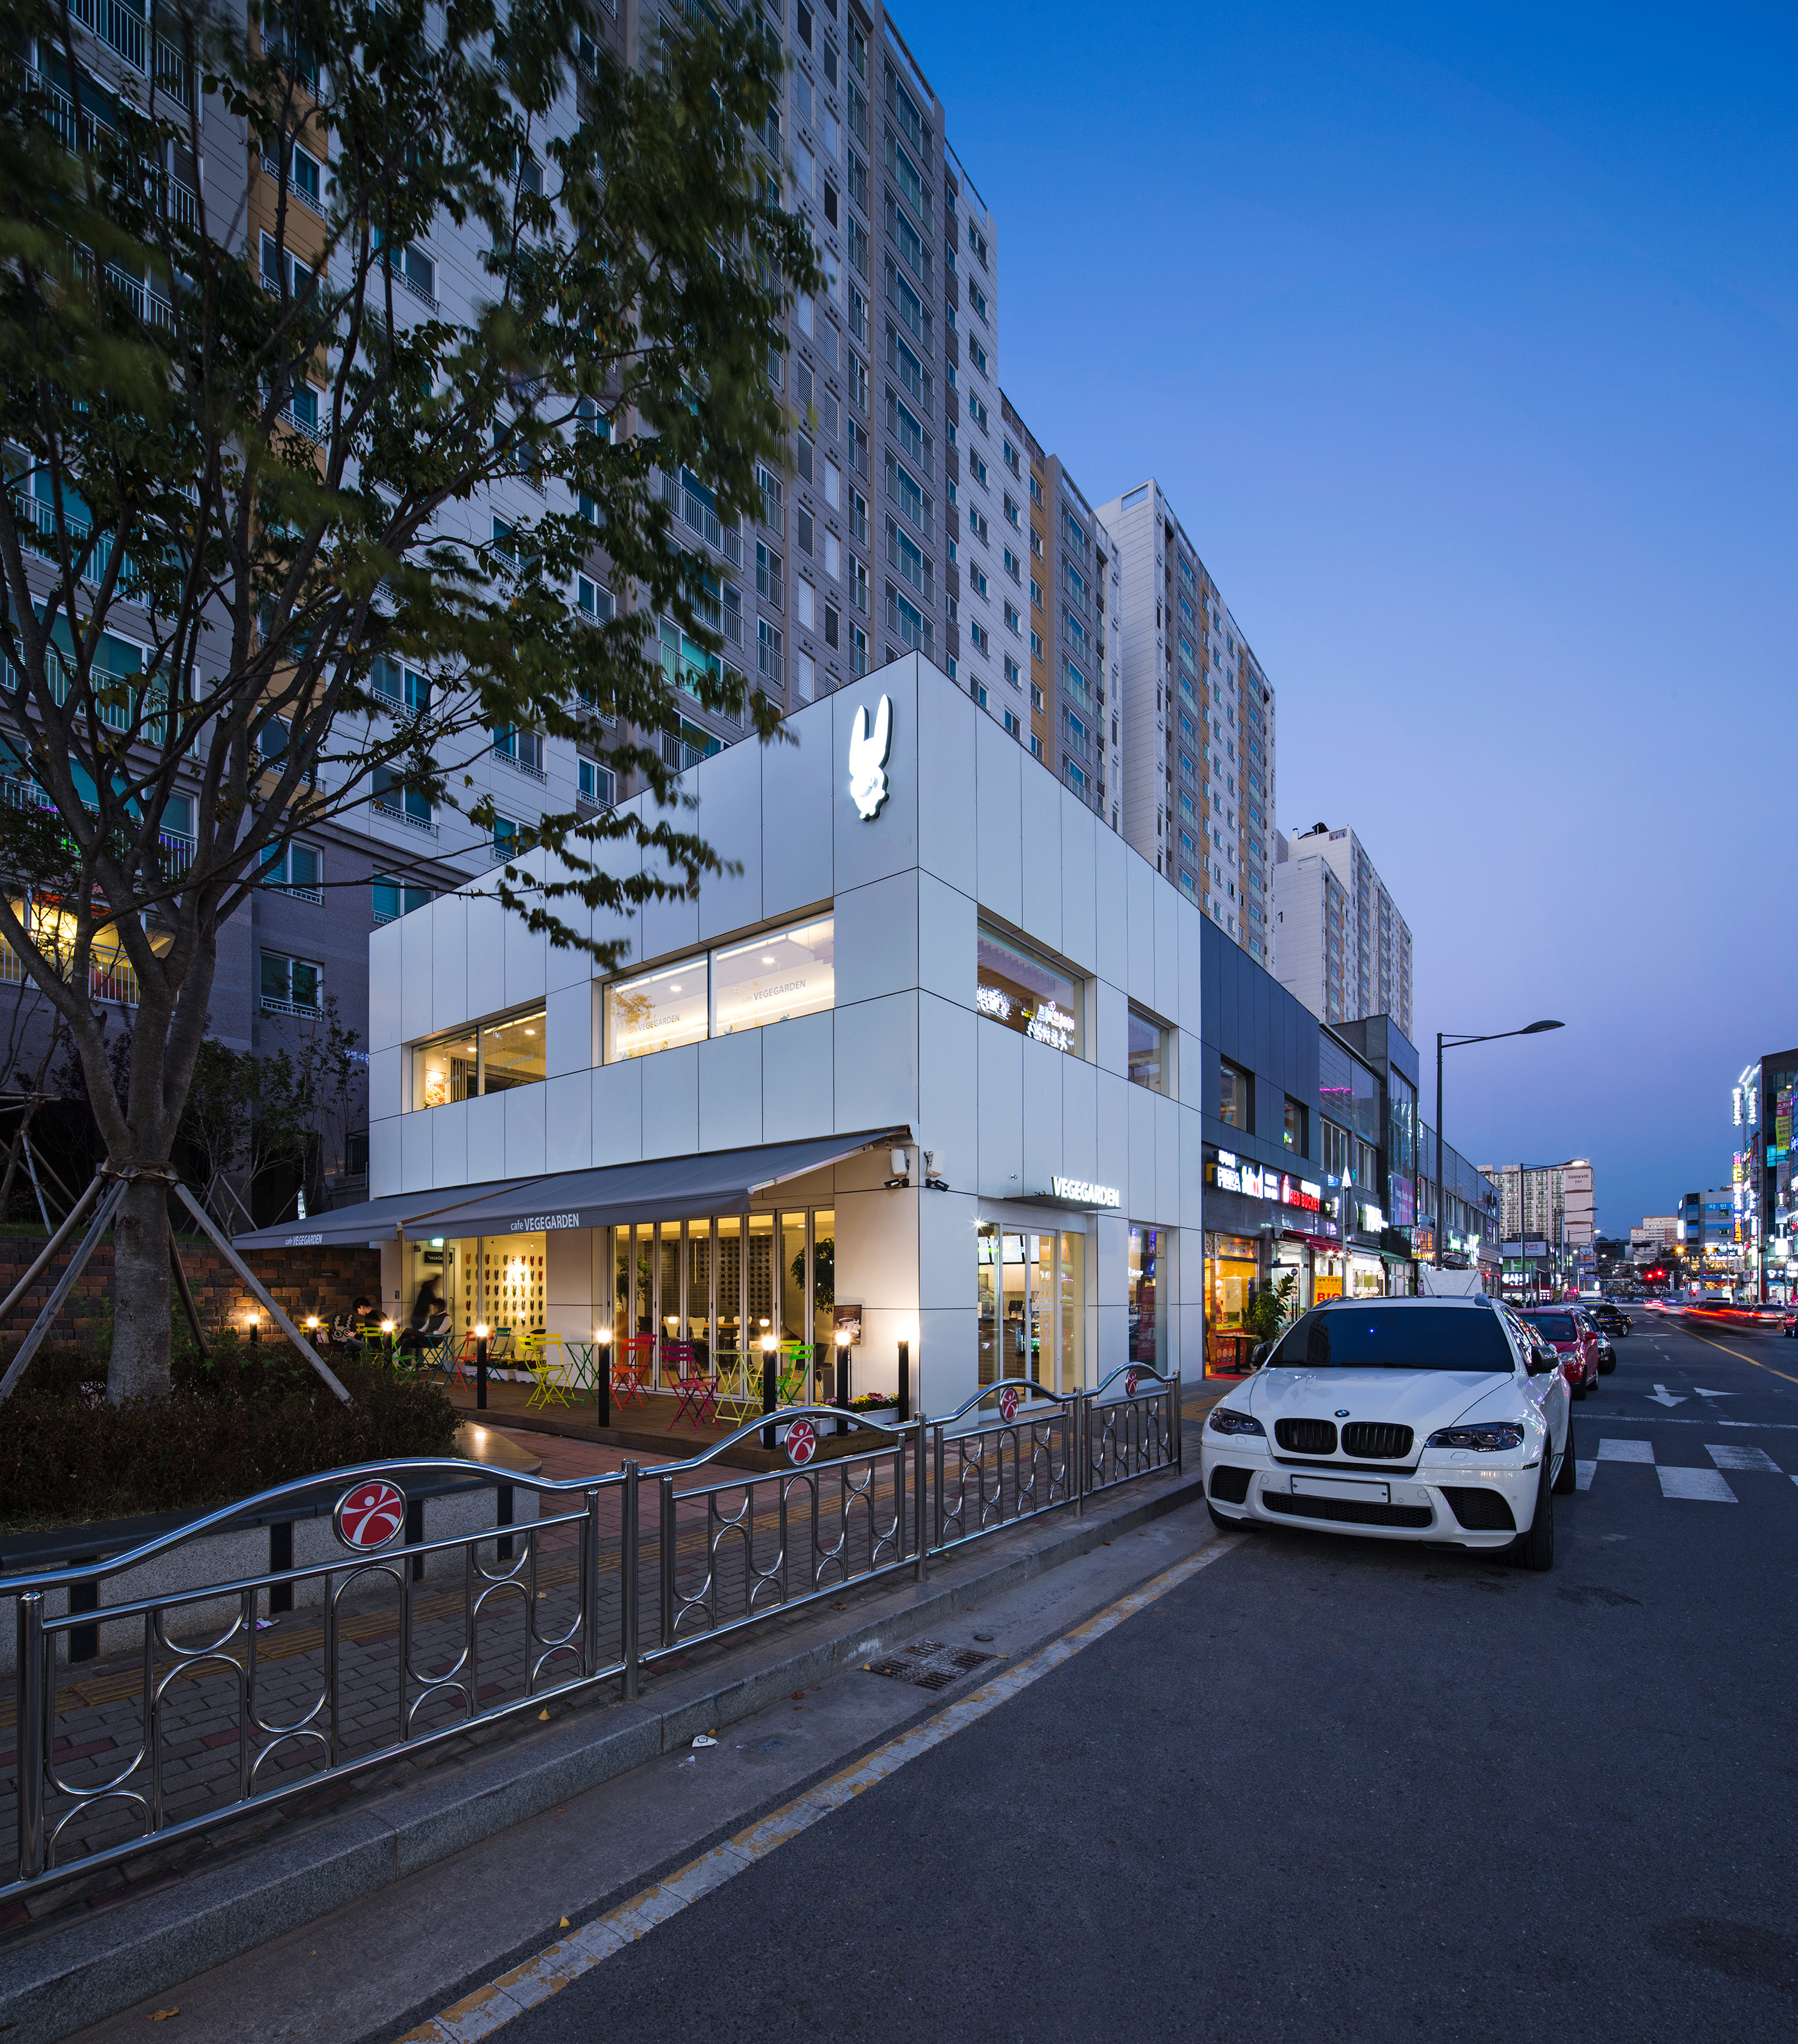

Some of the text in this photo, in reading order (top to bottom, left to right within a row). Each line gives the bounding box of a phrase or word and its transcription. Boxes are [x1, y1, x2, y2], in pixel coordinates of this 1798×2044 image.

[741, 979, 806, 1003] cafe VEGEGARDEN
[638, 1014, 680, 1031] VEGEGARDEN
[504, 1053, 534, 1068] VEGEGARDEN
[1217, 1166, 1242, 1192] PIZZA
[1051, 1176, 1119, 1207] VEGEGARDEN
[1289, 1189, 1300, 1206] RED
[1300, 1192, 1320, 1212] BUCKET
[511, 1213, 579, 1231] cafe VEGEGARDEN
[285, 1234, 323, 1246] cafe VEGEGARDEN
[1034, 1292, 1052, 1301] Brunch
